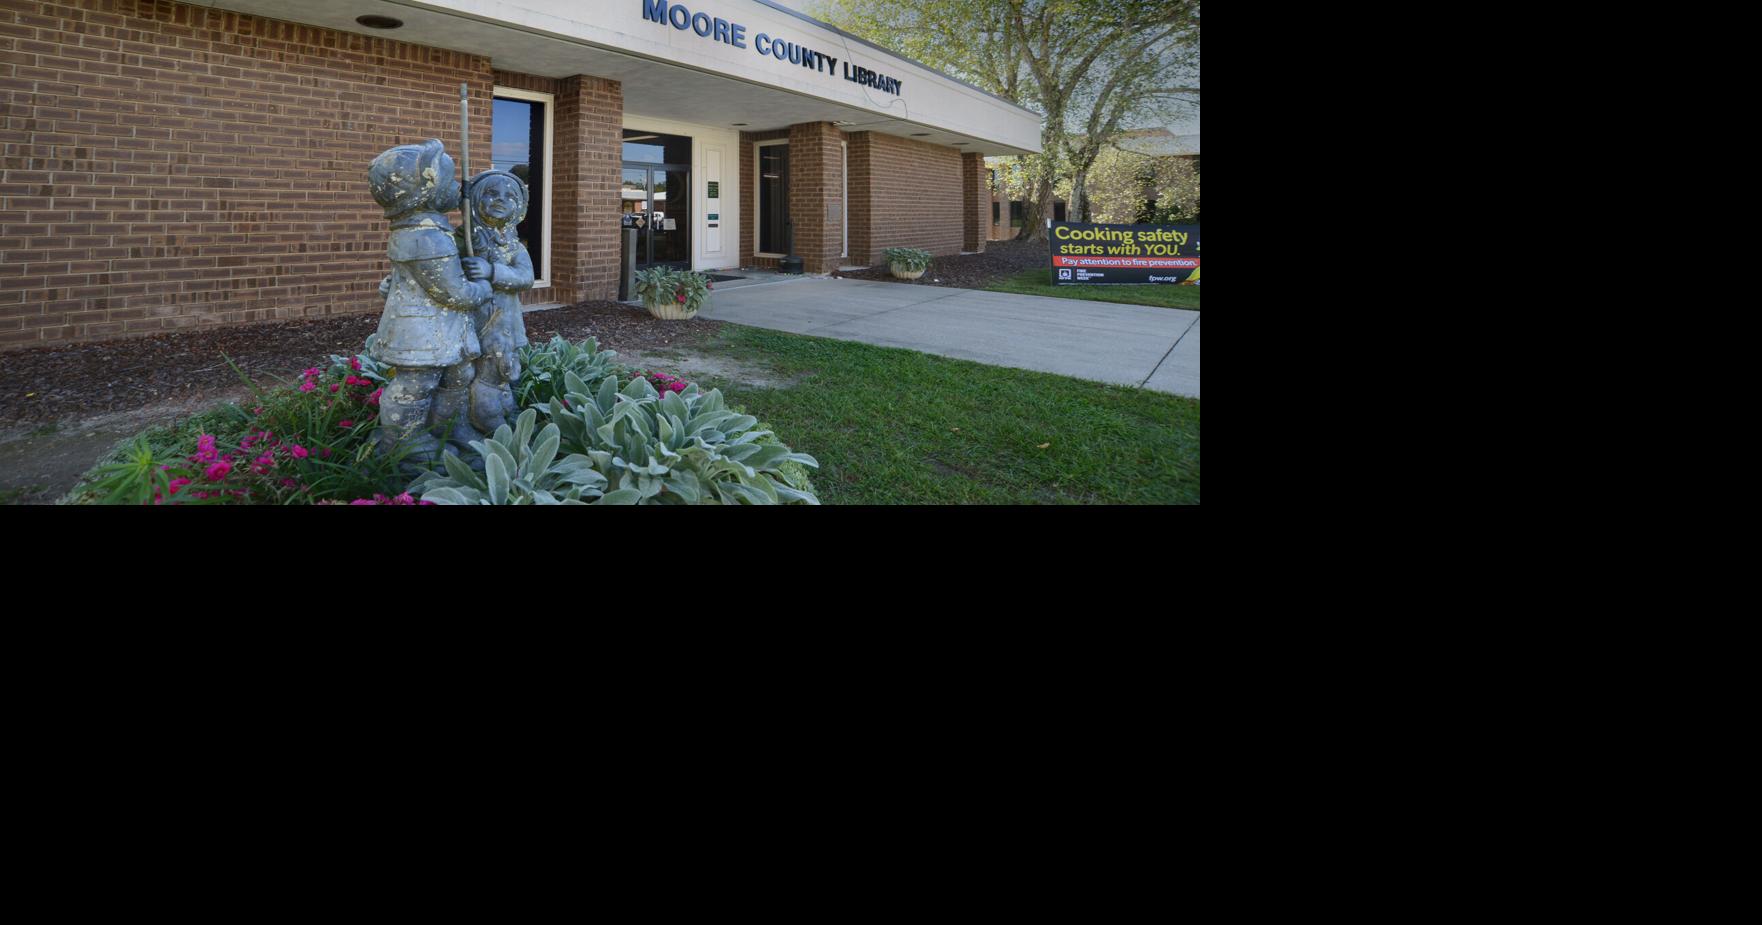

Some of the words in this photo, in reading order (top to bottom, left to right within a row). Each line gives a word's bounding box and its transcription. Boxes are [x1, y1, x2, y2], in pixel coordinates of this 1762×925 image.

[642, 0, 747, 49] MOORE
[755, 33, 837, 76] COUNTY
[844, 61, 902, 97] LIBRARY
[1055, 226, 1134, 244] Cooking
[1138, 229, 1188, 246] safety
[1060, 243, 1104, 255] starts
[1107, 244, 1141, 256] with
[1145, 243, 1181, 256] YOU.
[1061, 257, 1078, 267] Pay
[1080, 258, 1120, 266] attention
[1132, 258, 1147, 266] fire
